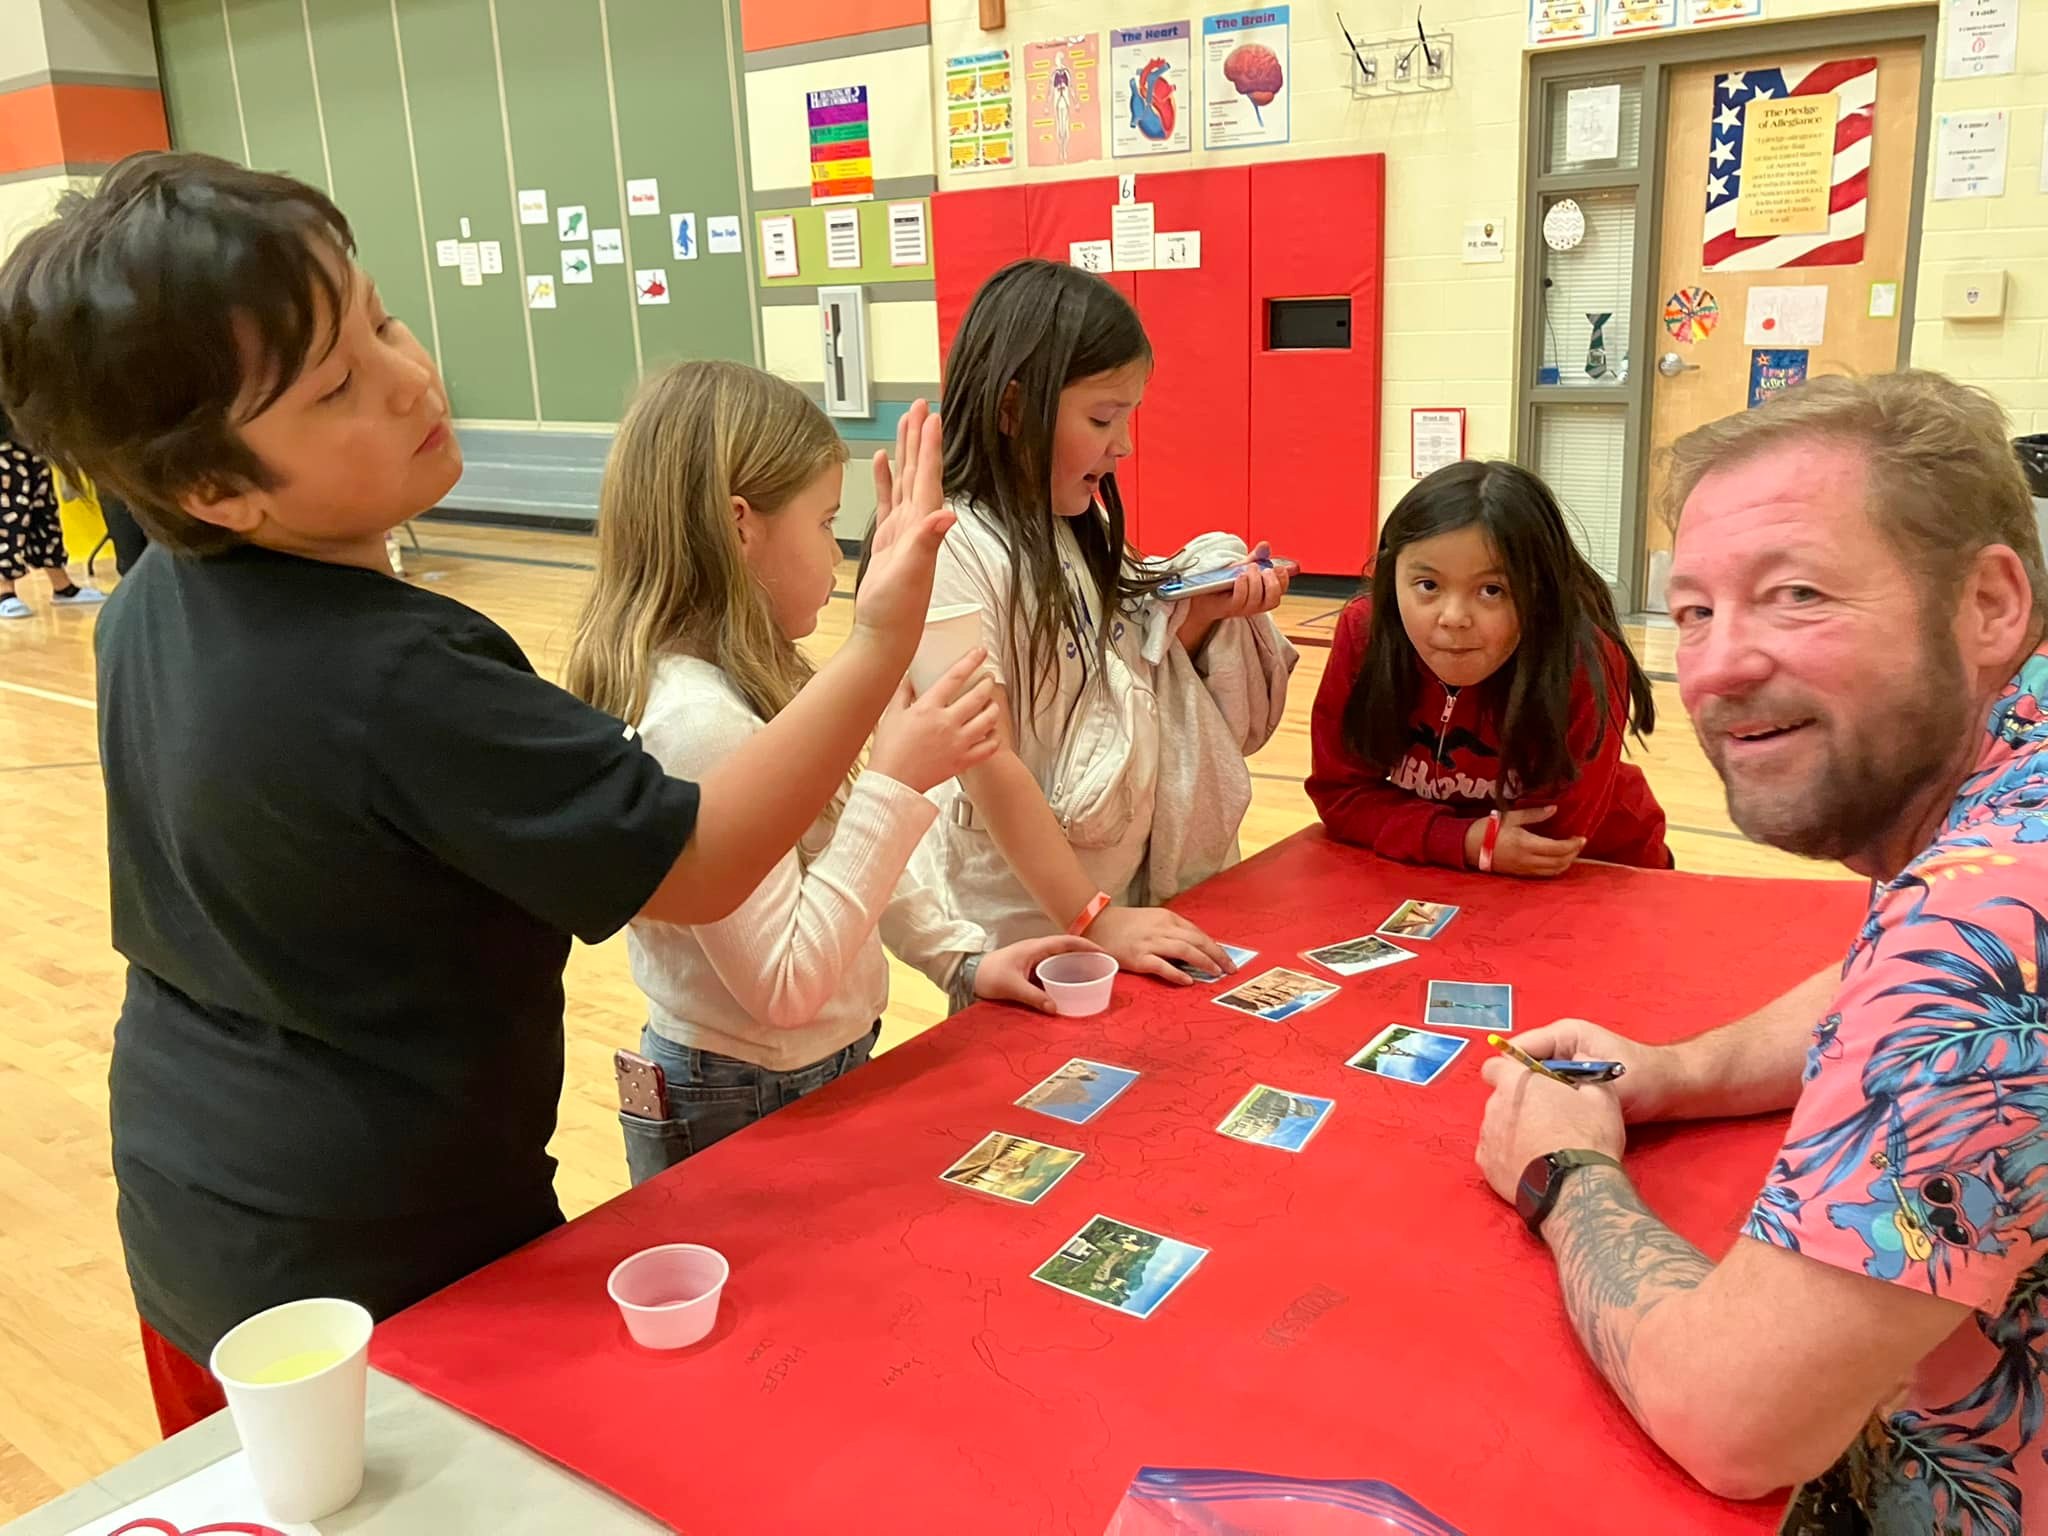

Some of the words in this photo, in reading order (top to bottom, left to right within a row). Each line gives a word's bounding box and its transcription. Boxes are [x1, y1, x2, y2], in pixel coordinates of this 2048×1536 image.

[1216, 19, 1238, 30] The
[1241, 12, 1276, 27] Brain
[1121, 32, 1142, 43] The
[1145, 26, 1178, 40] Heart
[1764, 109, 1783, 118] The
[1784, 105, 1819, 116] Pledge
[1758, 121, 1768, 129] of
[1769, 116, 1822, 128] Allegiance
[1121, 178, 1131, 199] 6
